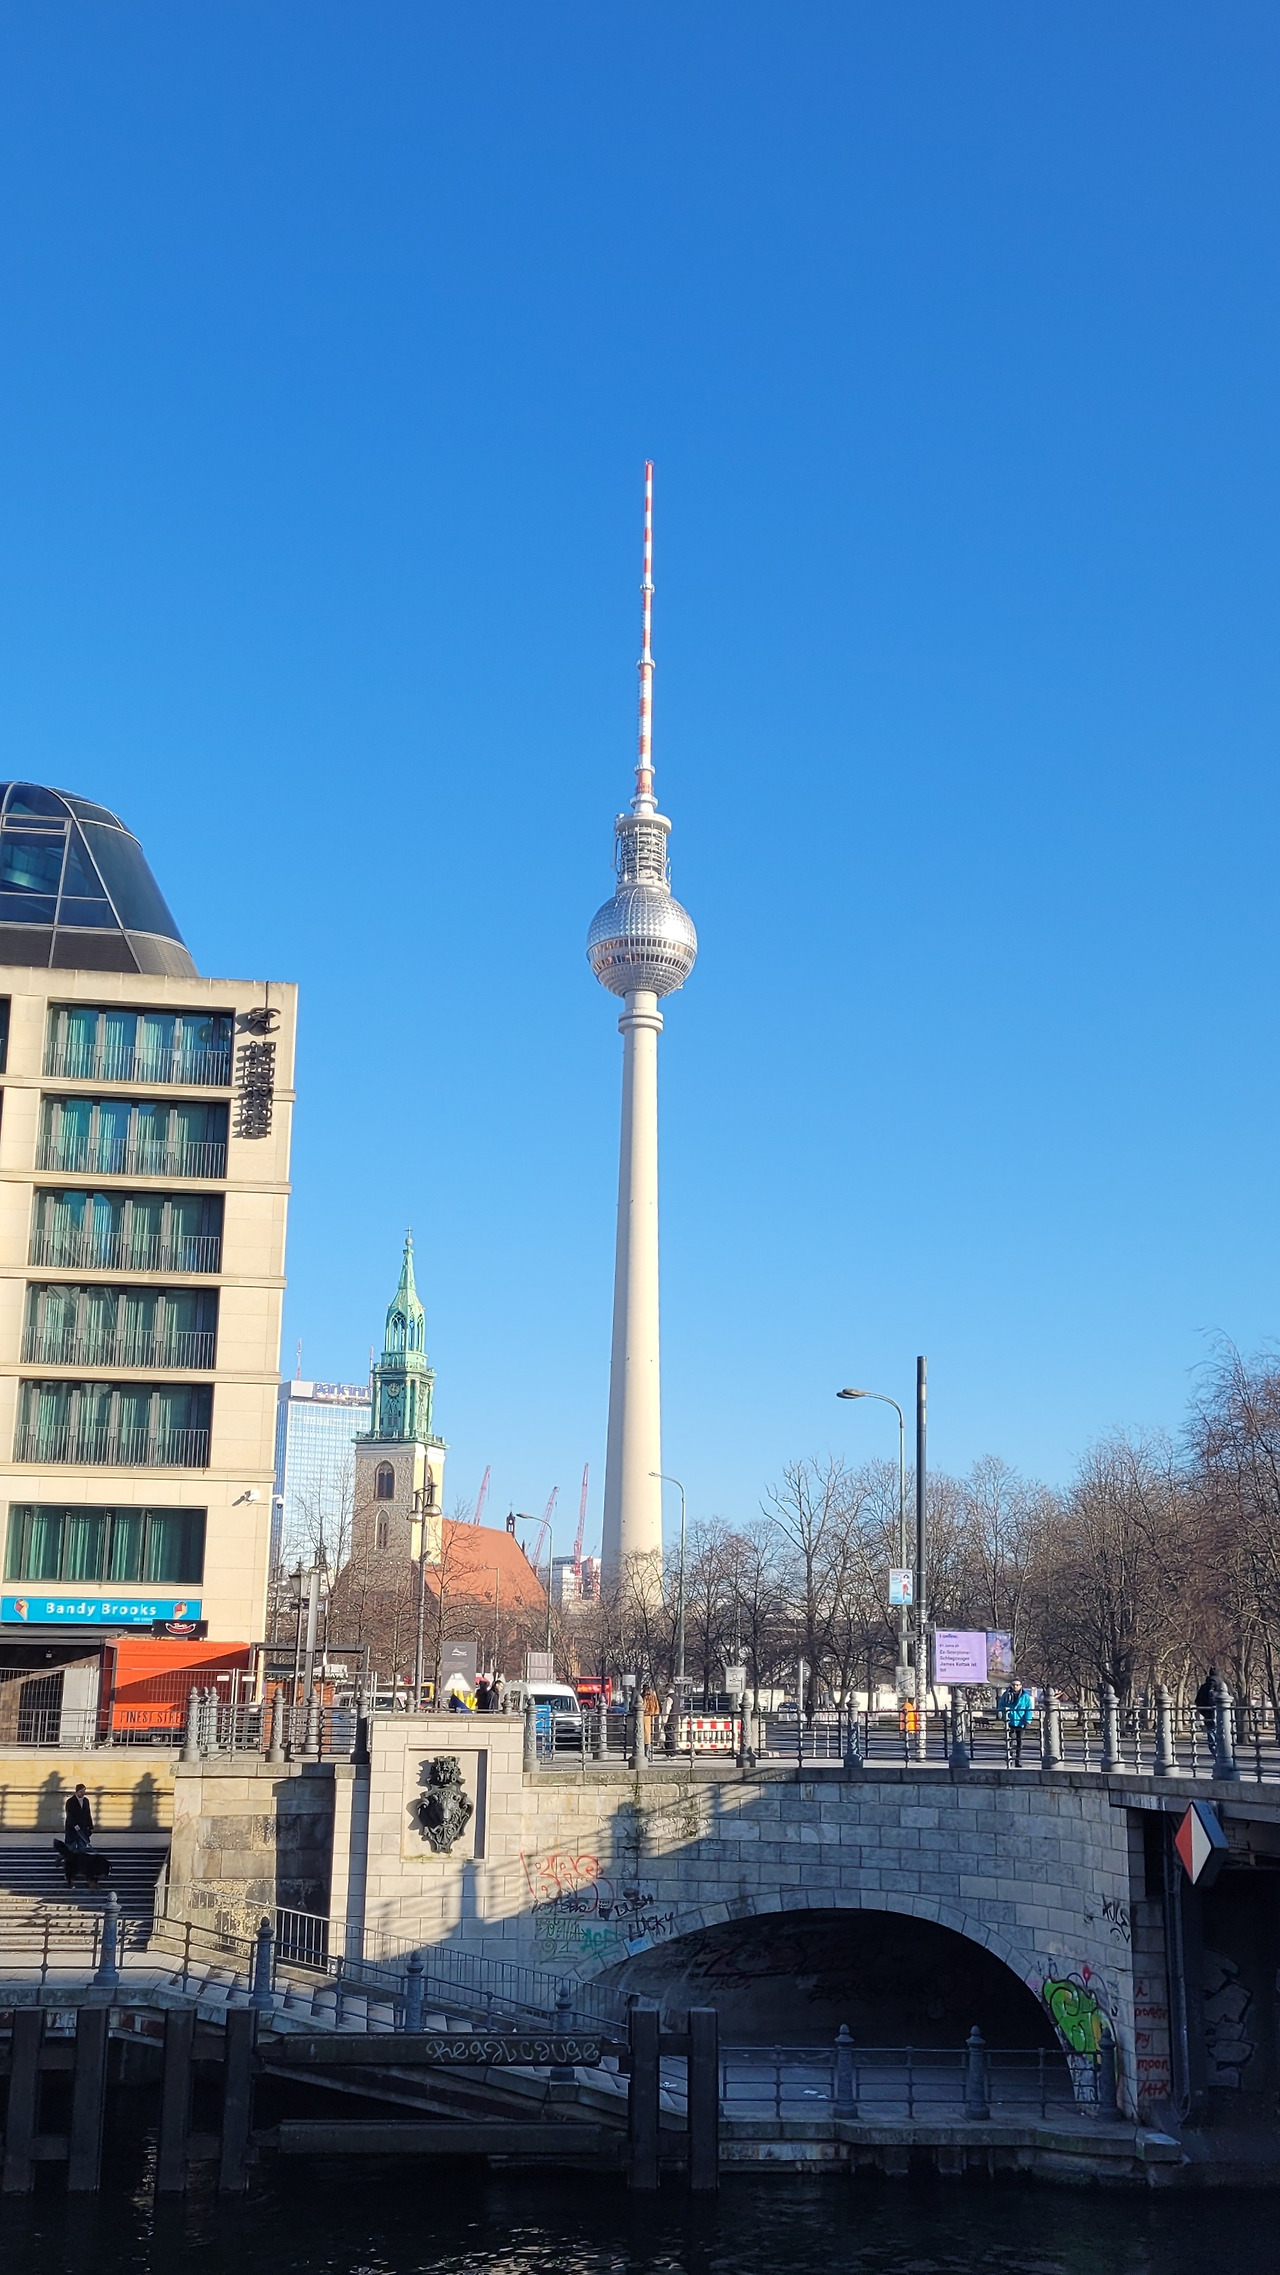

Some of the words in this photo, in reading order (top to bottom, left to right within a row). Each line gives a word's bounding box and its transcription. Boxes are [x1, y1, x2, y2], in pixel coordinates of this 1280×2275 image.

[258, 1042, 276, 1136] RADISSON
[46, 1602, 96, 1617] Bandy
[101, 1603, 157, 1616] Brooks
[120, 1710, 154, 1724] FINEST
[1137, 2058, 1169, 2073] moon
